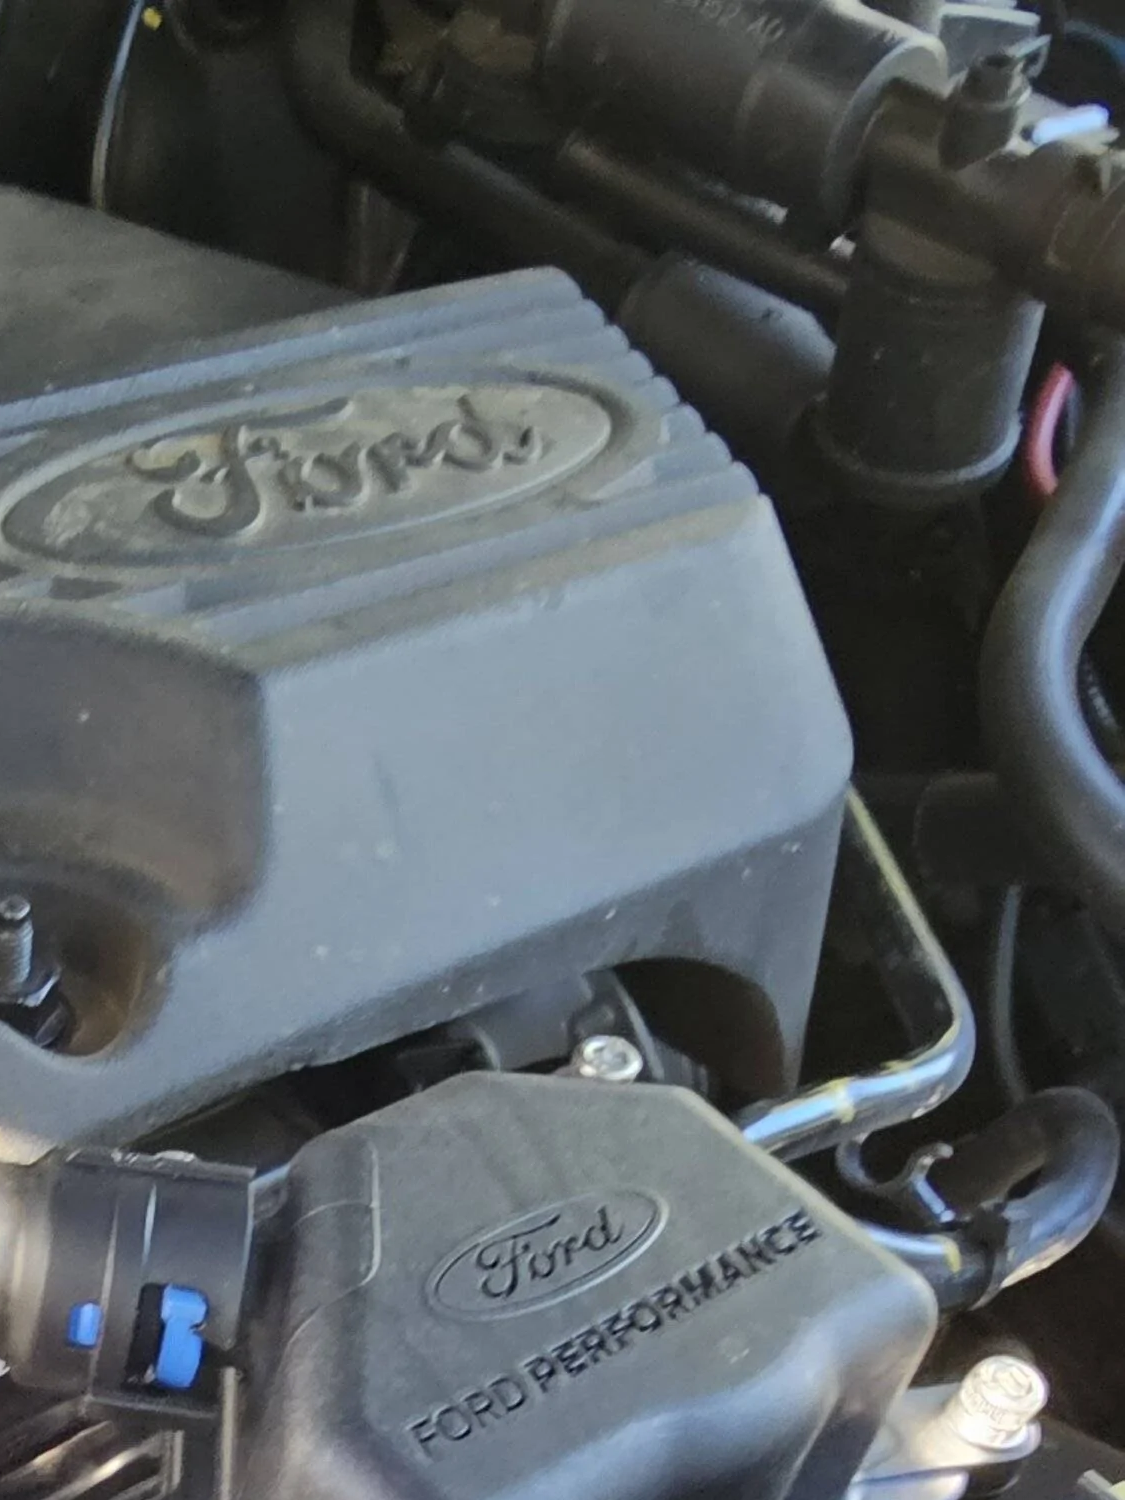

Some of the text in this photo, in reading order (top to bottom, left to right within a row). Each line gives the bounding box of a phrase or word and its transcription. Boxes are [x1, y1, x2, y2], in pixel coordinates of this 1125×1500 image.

[129, 393, 545, 541] Ford
[475, 1204, 623, 1299] Ford
[407, 1206, 822, 1459] FORD PERFORMANCE
